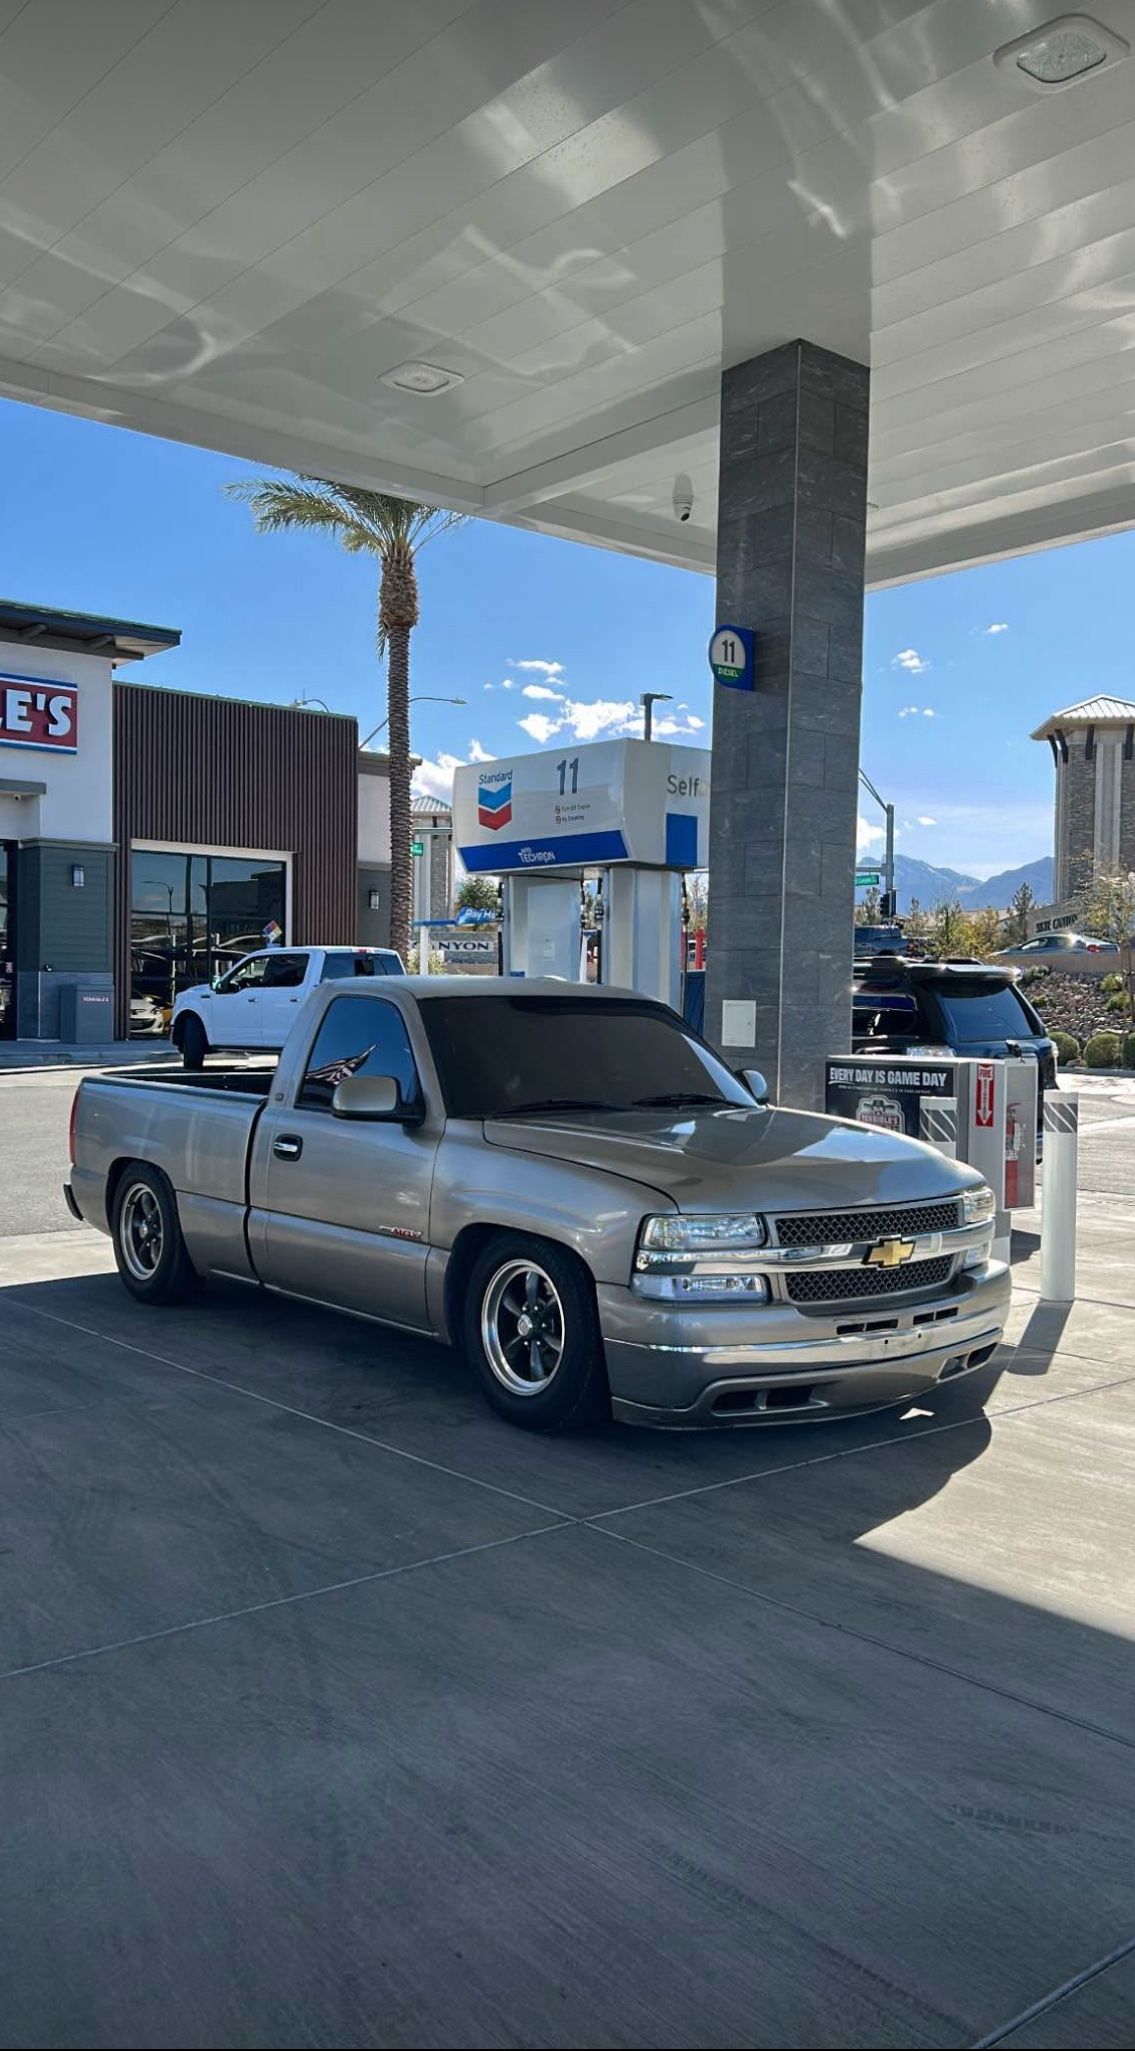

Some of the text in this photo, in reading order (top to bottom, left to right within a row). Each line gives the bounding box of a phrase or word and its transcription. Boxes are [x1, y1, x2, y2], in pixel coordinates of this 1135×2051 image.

[721, 639, 736, 664] 11
[0, 688, 72, 737] E'S
[479, 769, 513, 785] Standard
[557, 758, 579, 796] 11
[667, 774, 700, 797] Self
[518, 851, 556, 863] TECHRON
[830, 1067, 947, 1087] EVERY DAY IS GAME DAY
